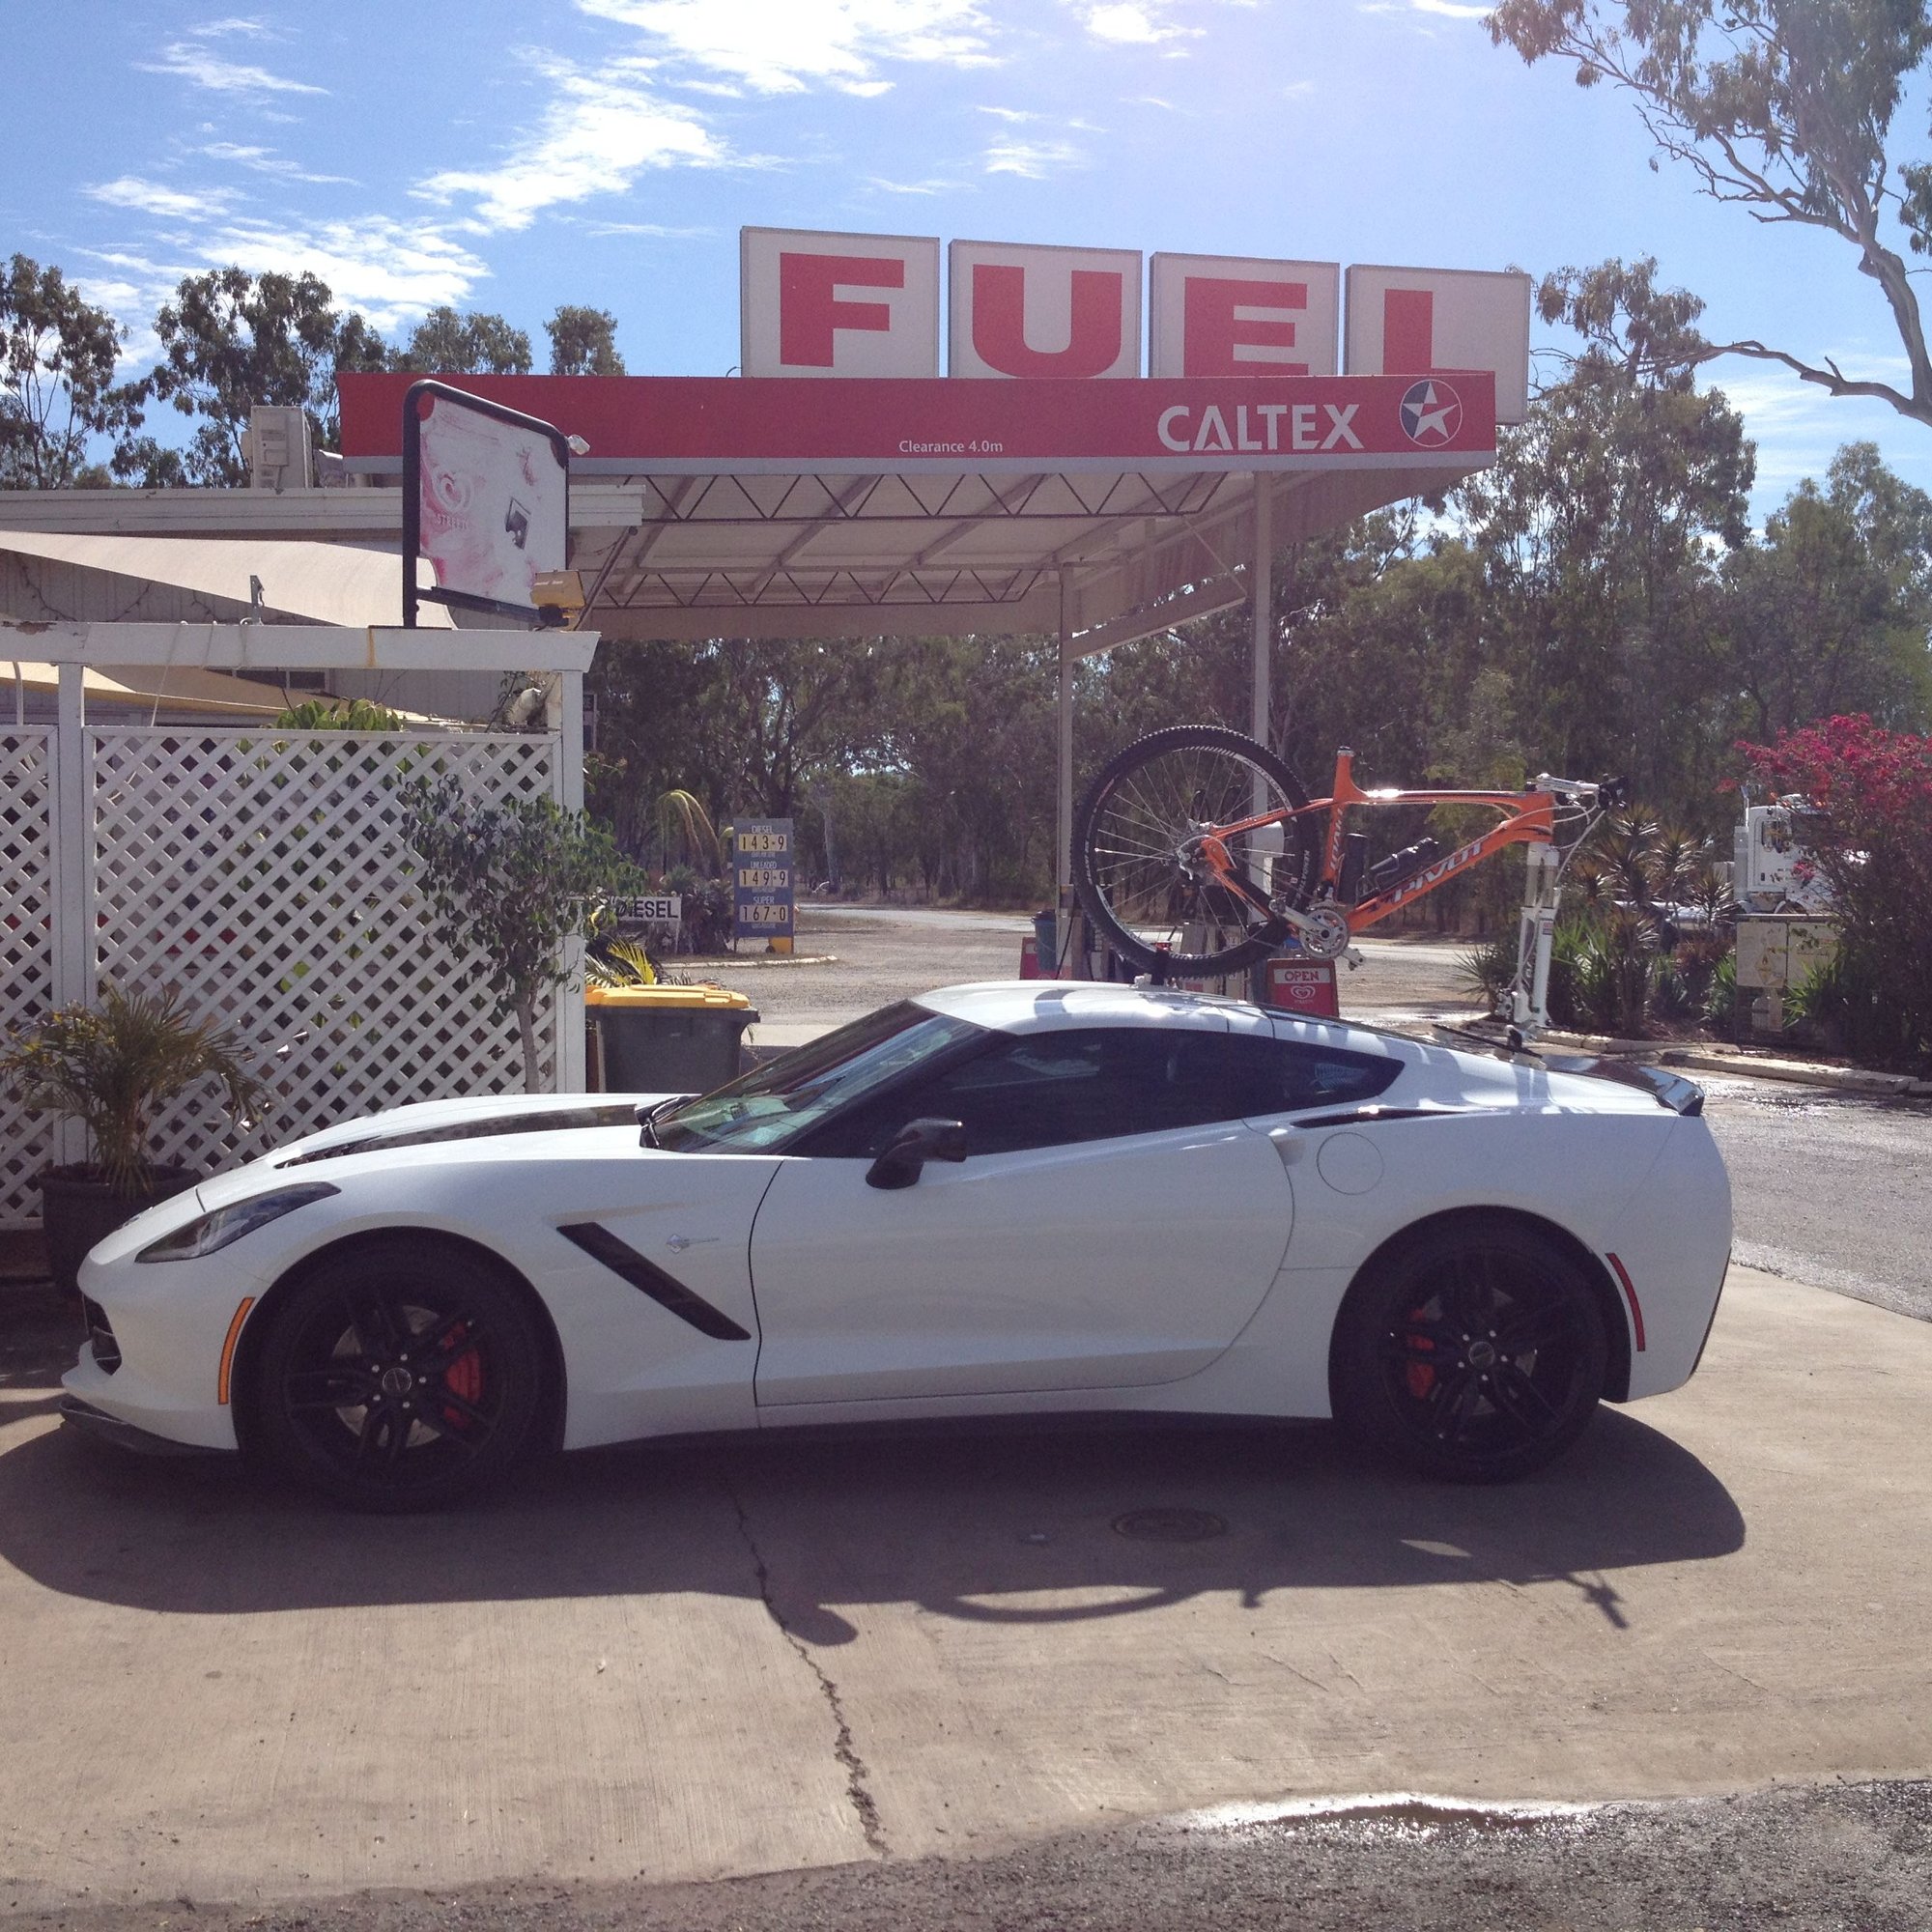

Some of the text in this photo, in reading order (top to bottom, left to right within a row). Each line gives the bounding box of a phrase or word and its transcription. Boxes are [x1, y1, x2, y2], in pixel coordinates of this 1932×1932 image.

[780, 252, 1493, 379] FUEL
[1157, 404, 1365, 452] CALTEX
[898, 440, 1004, 453] Clearance 4.0m
[751, 825, 773, 834] DIESEL
[1394, 841, 1482, 903] PIVOT
[753, 895, 775, 904] SUPER
[616, 899, 678, 918] DIESEL
[1284, 970, 1320, 982] OPEN
